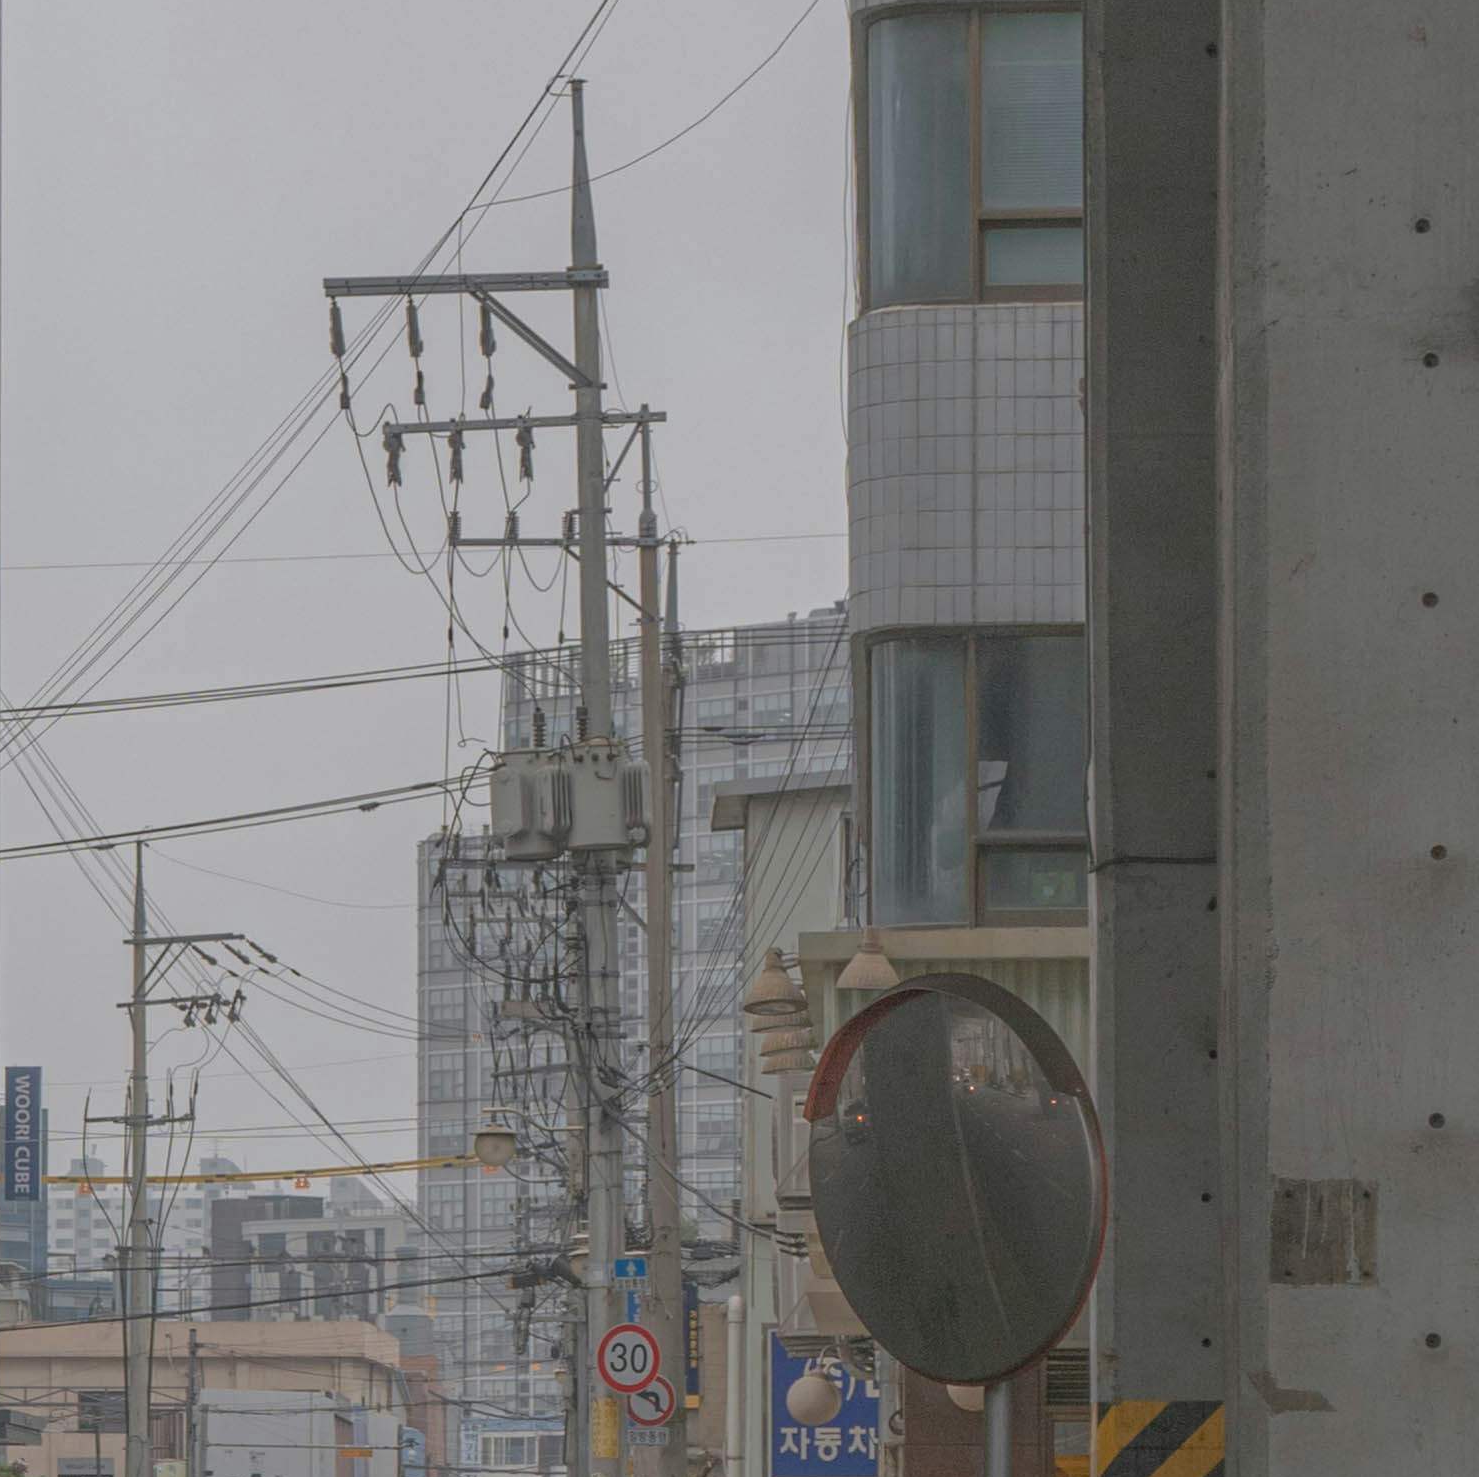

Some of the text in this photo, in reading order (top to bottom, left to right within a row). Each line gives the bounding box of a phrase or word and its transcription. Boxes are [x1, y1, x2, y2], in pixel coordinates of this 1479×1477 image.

[14, 1074, 31, 1193] WOORI CUBE
[610, 1342, 647, 1373] 30
[780, 1425, 879, 1462] 자동차
